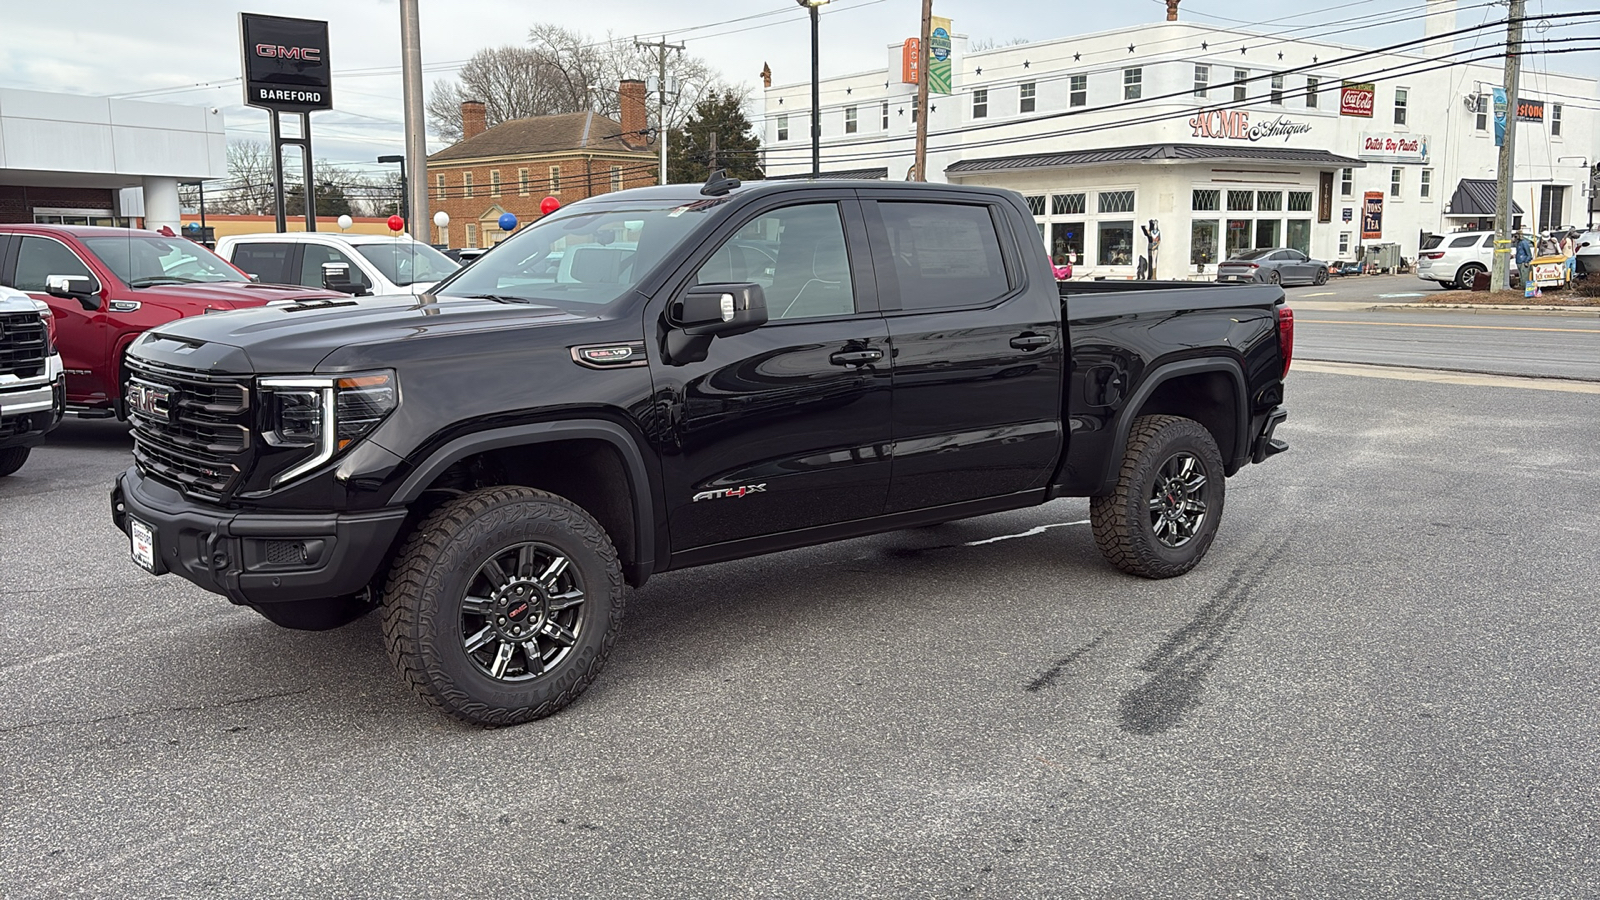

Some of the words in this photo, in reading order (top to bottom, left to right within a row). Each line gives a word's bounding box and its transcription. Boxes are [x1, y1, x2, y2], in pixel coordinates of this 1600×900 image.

[256, 44, 321, 61] GMC
[260, 89, 321, 102] BAREFORD
[1188, 107, 1250, 140] ACME
[1365, 137, 1384, 151] Dutch
[1385, 138, 1398, 154] Boy
[1397, 138, 1418, 152] Paints
[1366, 217, 1380, 230] TEA
[128, 384, 169, 418] GMC
[692, 483, 767, 503] AT4X
[508, 602, 528, 619] GMC
